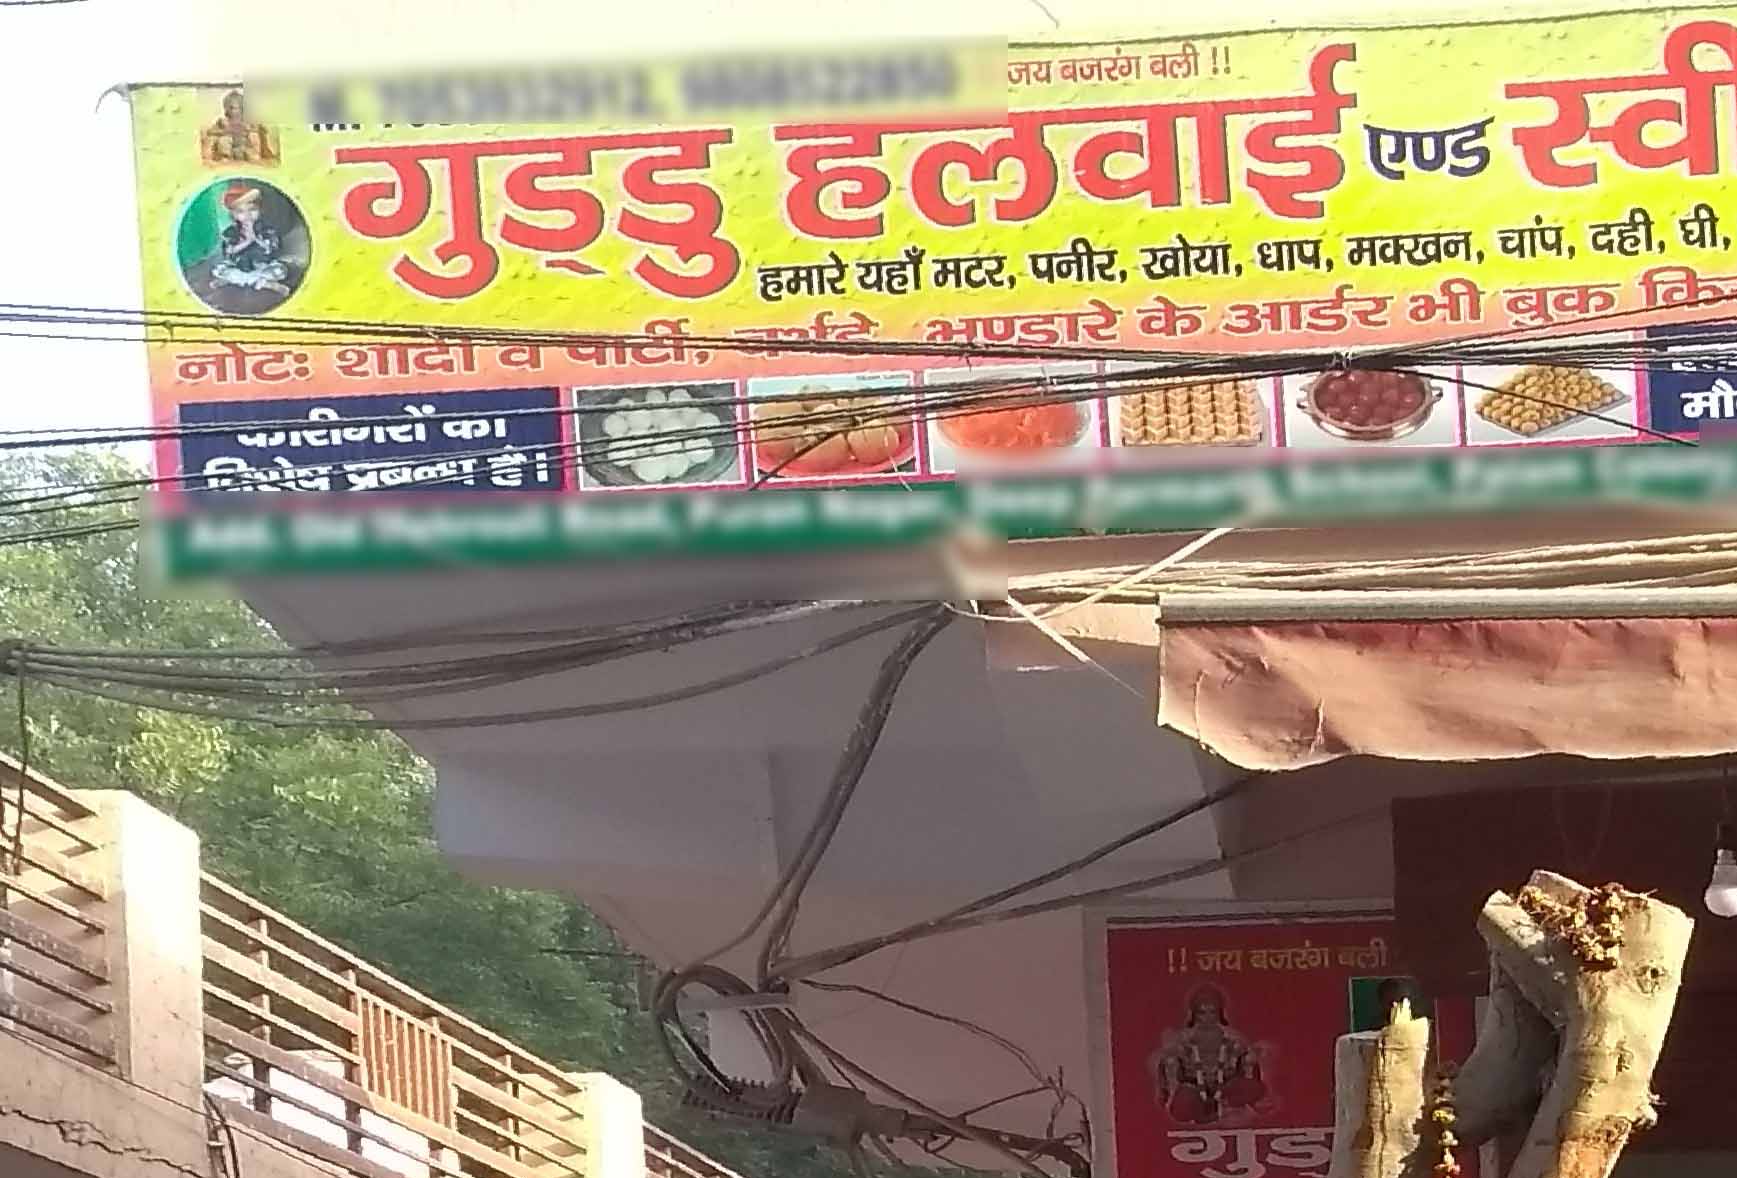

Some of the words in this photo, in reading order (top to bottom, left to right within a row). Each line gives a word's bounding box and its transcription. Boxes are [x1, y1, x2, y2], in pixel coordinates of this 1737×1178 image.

[1058, 46, 1141, 83] बजरंग
[1148, 43, 1200, 79] बली
[334, 128, 741, 300] गुड्डु
[773, 42, 1358, 240] हलवाई
[1364, 116, 1495, 181] एण्ड
[758, 251, 848, 301] हमारे
[857, 245, 926, 296] यहाँ
[931, 253, 1017, 290] मटर,
[1028, 237, 1128, 285] पनीर,
[1138, 232, 1244, 281] खोया,
[1257, 238, 1334, 273] धाप,
[1497, 213, 1576, 260] चांप,
[1589, 207, 1667, 258] दही,
[1678, 202, 1732, 253] घी,
[1137, 295, 1208, 337] के
[1222, 283, 1394, 334] आर्डर
[1409, 276, 1485, 323] भी
[1502, 283, 1624, 322] बुक
[1196, 950, 1242, 973] जय
[1249, 938, 1331, 971] बजरंग
[1337, 937, 1388, 969] बली
